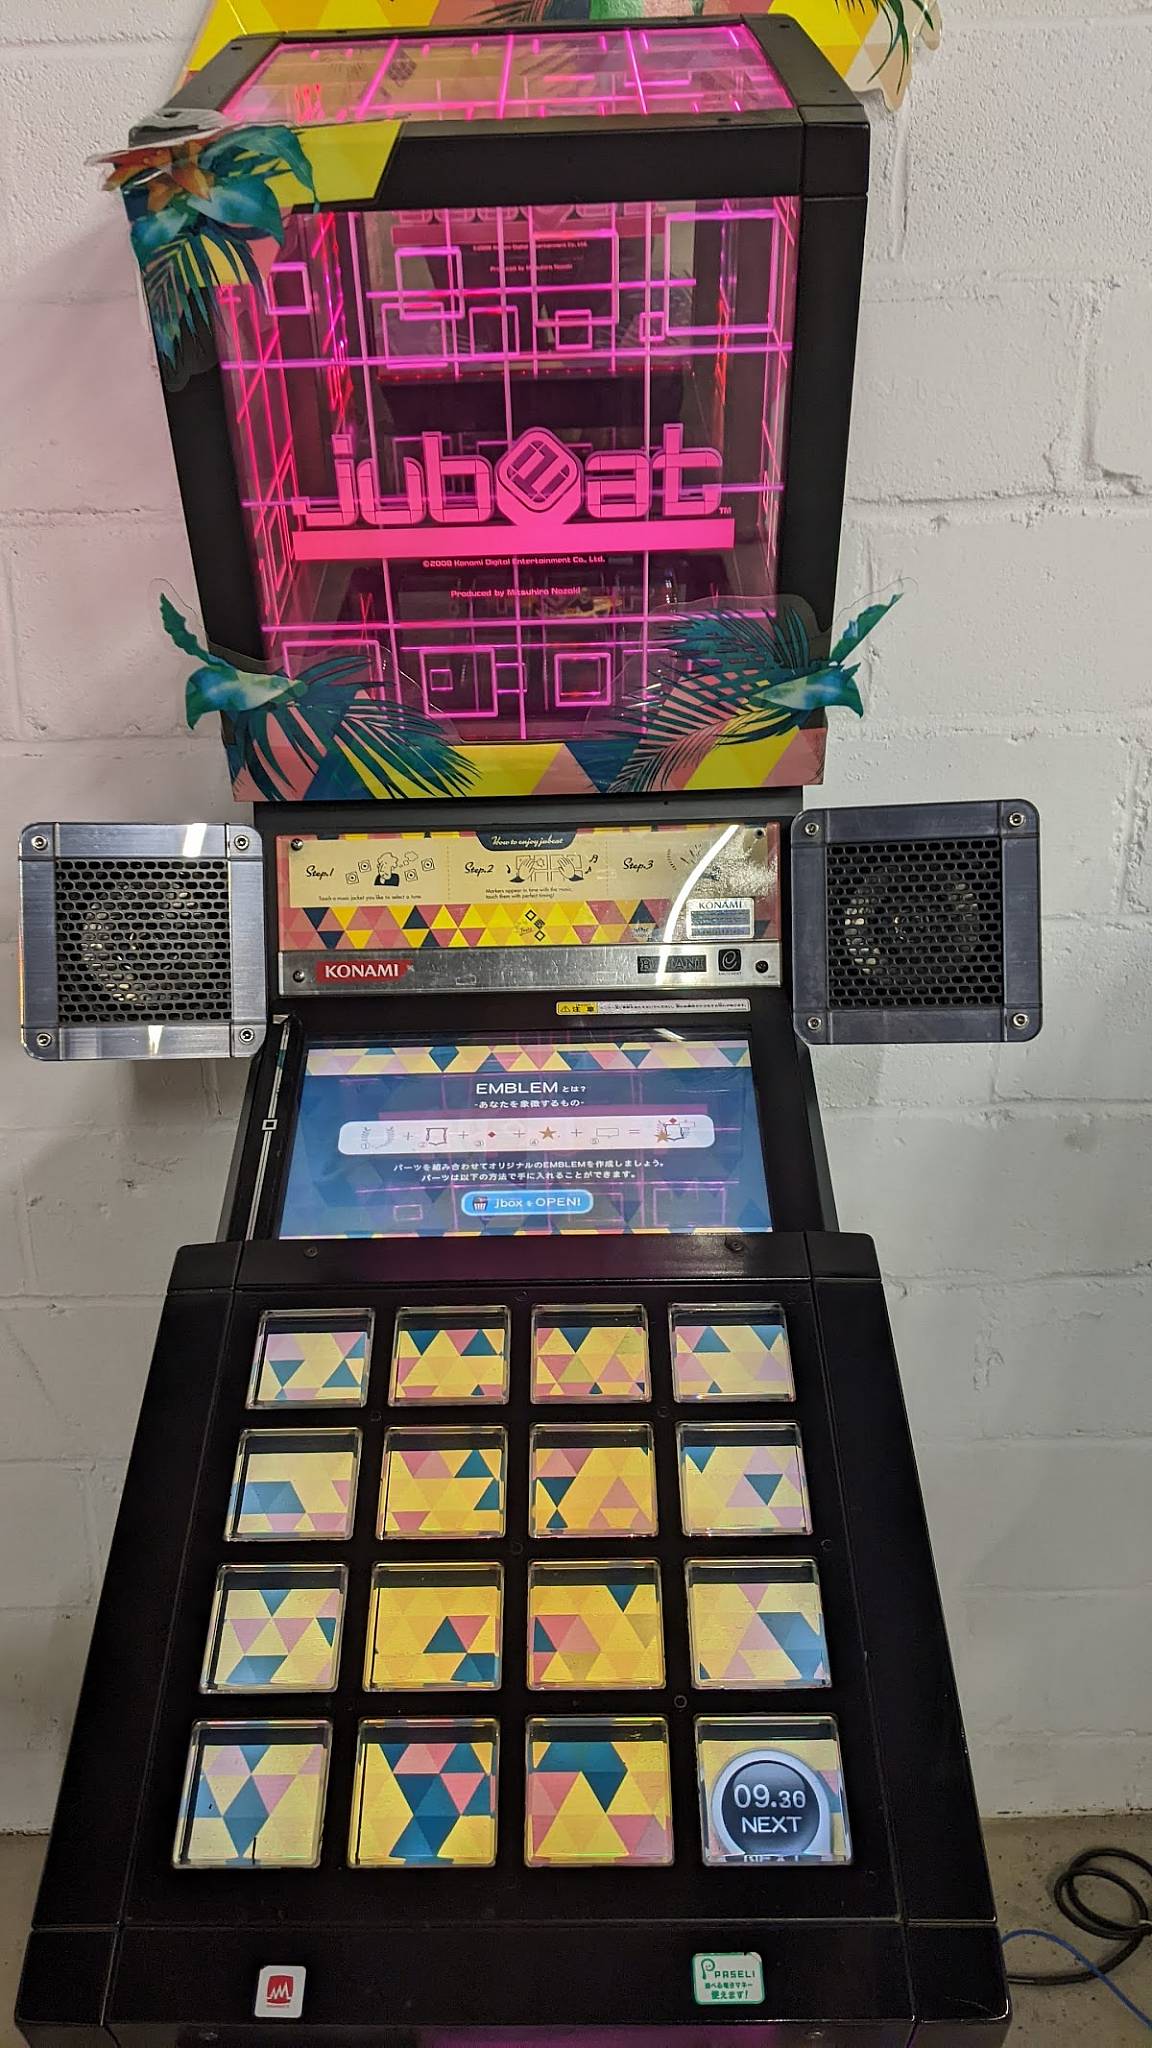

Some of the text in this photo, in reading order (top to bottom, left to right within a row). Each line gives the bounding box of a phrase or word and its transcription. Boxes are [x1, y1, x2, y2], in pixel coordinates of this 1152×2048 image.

[454, 559, 484, 567] Konami
[485, 557, 511, 567] Digital
[589, 555, 606, 563] Ltd.
[450, 589, 492, 598] Produced
[494, 589, 505, 598] by
[491, 835, 510, 846] How
[699, 900, 742, 909] KONAMI
[324, 963, 400, 978] KONAMI
[475, 1081, 559, 1095] EMBLEM
[742, 1816, 803, 1834] NEXT
[714, 1970, 756, 1978] PASELI
